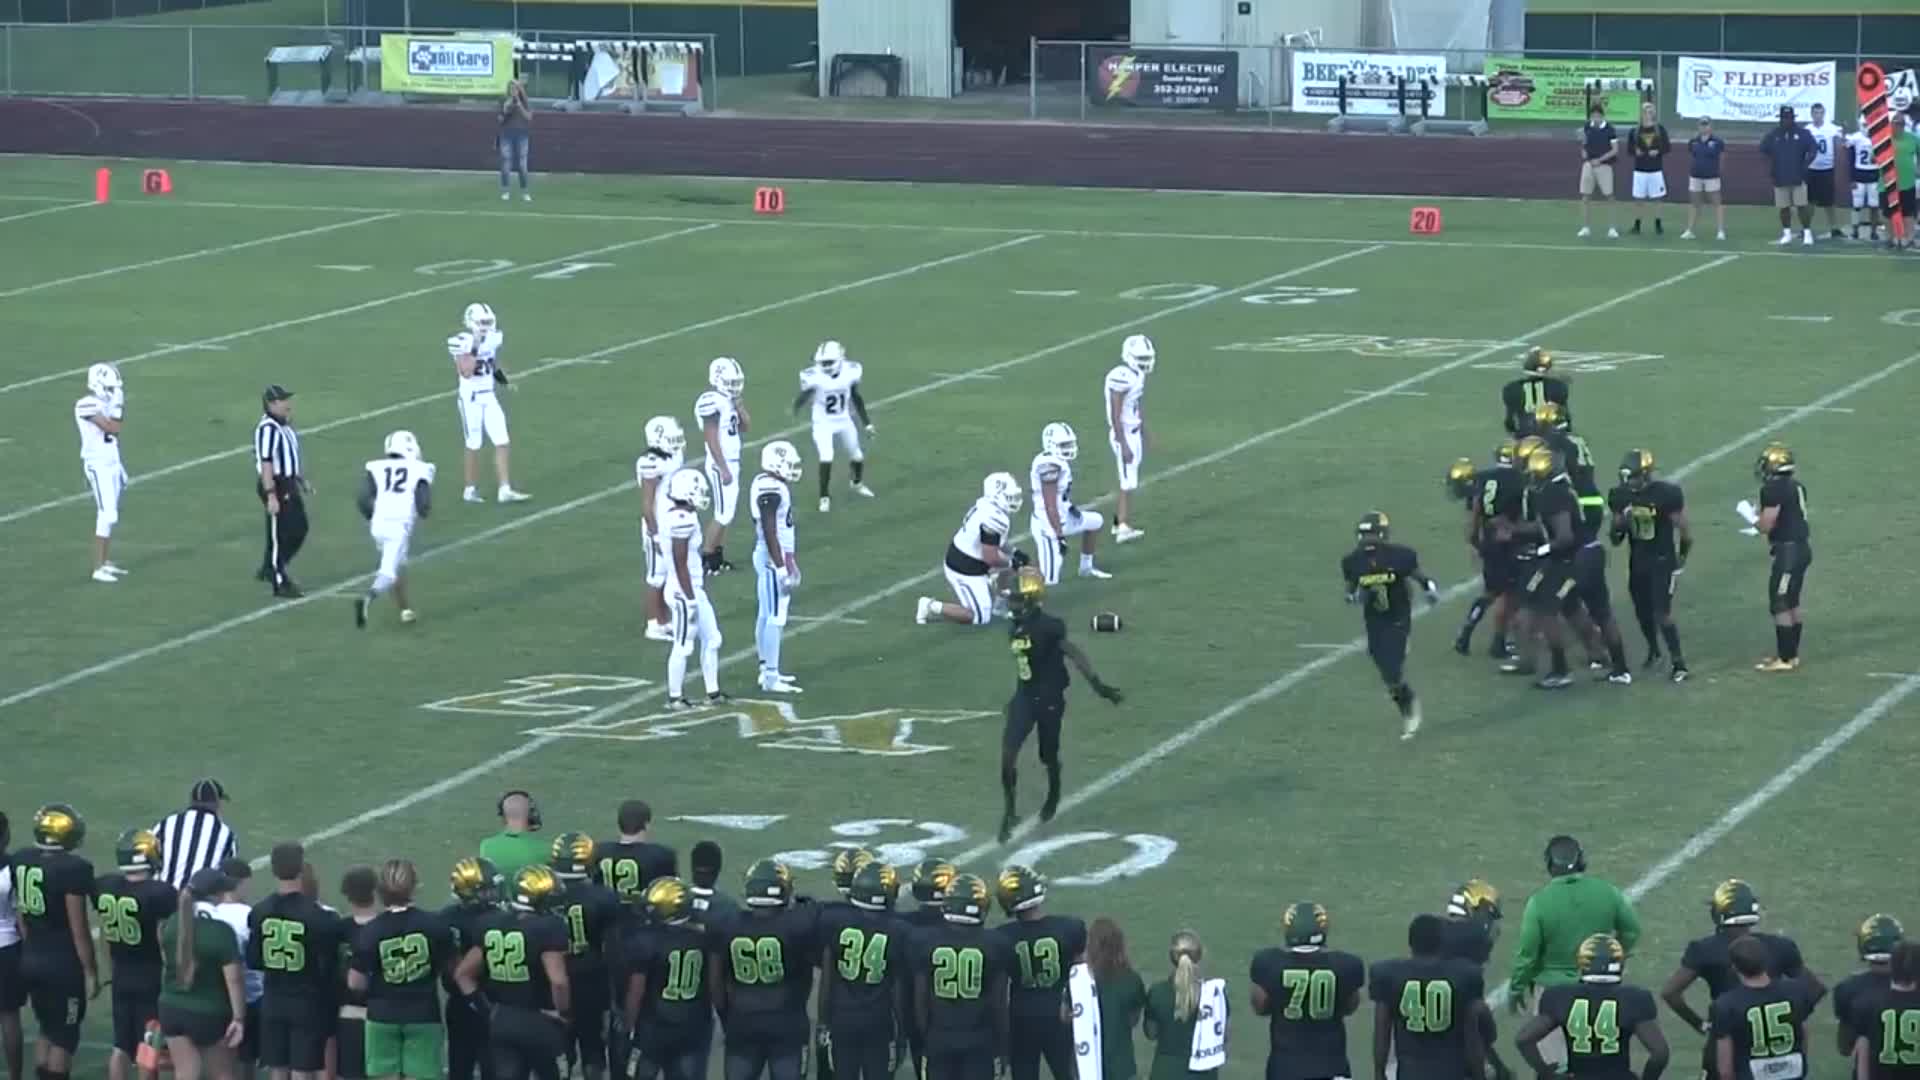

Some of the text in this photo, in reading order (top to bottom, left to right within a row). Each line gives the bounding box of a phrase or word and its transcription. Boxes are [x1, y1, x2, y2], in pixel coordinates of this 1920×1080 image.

[1163, 63, 1225, 73] ELECTRIC
[1724, 71, 1830, 87] FLIPPERS
[758, 189, 780, 211] 10
[1413, 210, 1437, 232] 20
[826, 393, 846, 415] 21
[383, 466, 409, 493] 12
[16, 864, 46, 916] 16
[600, 857, 641, 904] 12
[98, 893, 142, 946] 26
[261, 917, 305, 972] 25
[379, 932, 432, 984] 52
[484, 929, 530, 983] 22
[662, 948, 704, 1001] 10
[729, 936, 785, 985] 68
[838, 927, 888, 985] 34
[932, 946, 984, 999] 20
[1014, 936, 1062, 989] 13
[1282, 969, 1337, 1020] 70
[1399, 980, 1454, 1033] 40
[1565, 999, 1620, 1054] 44
[1746, 1001, 1795, 1056] 15
[1879, 1008, 1920, 1065] 19
